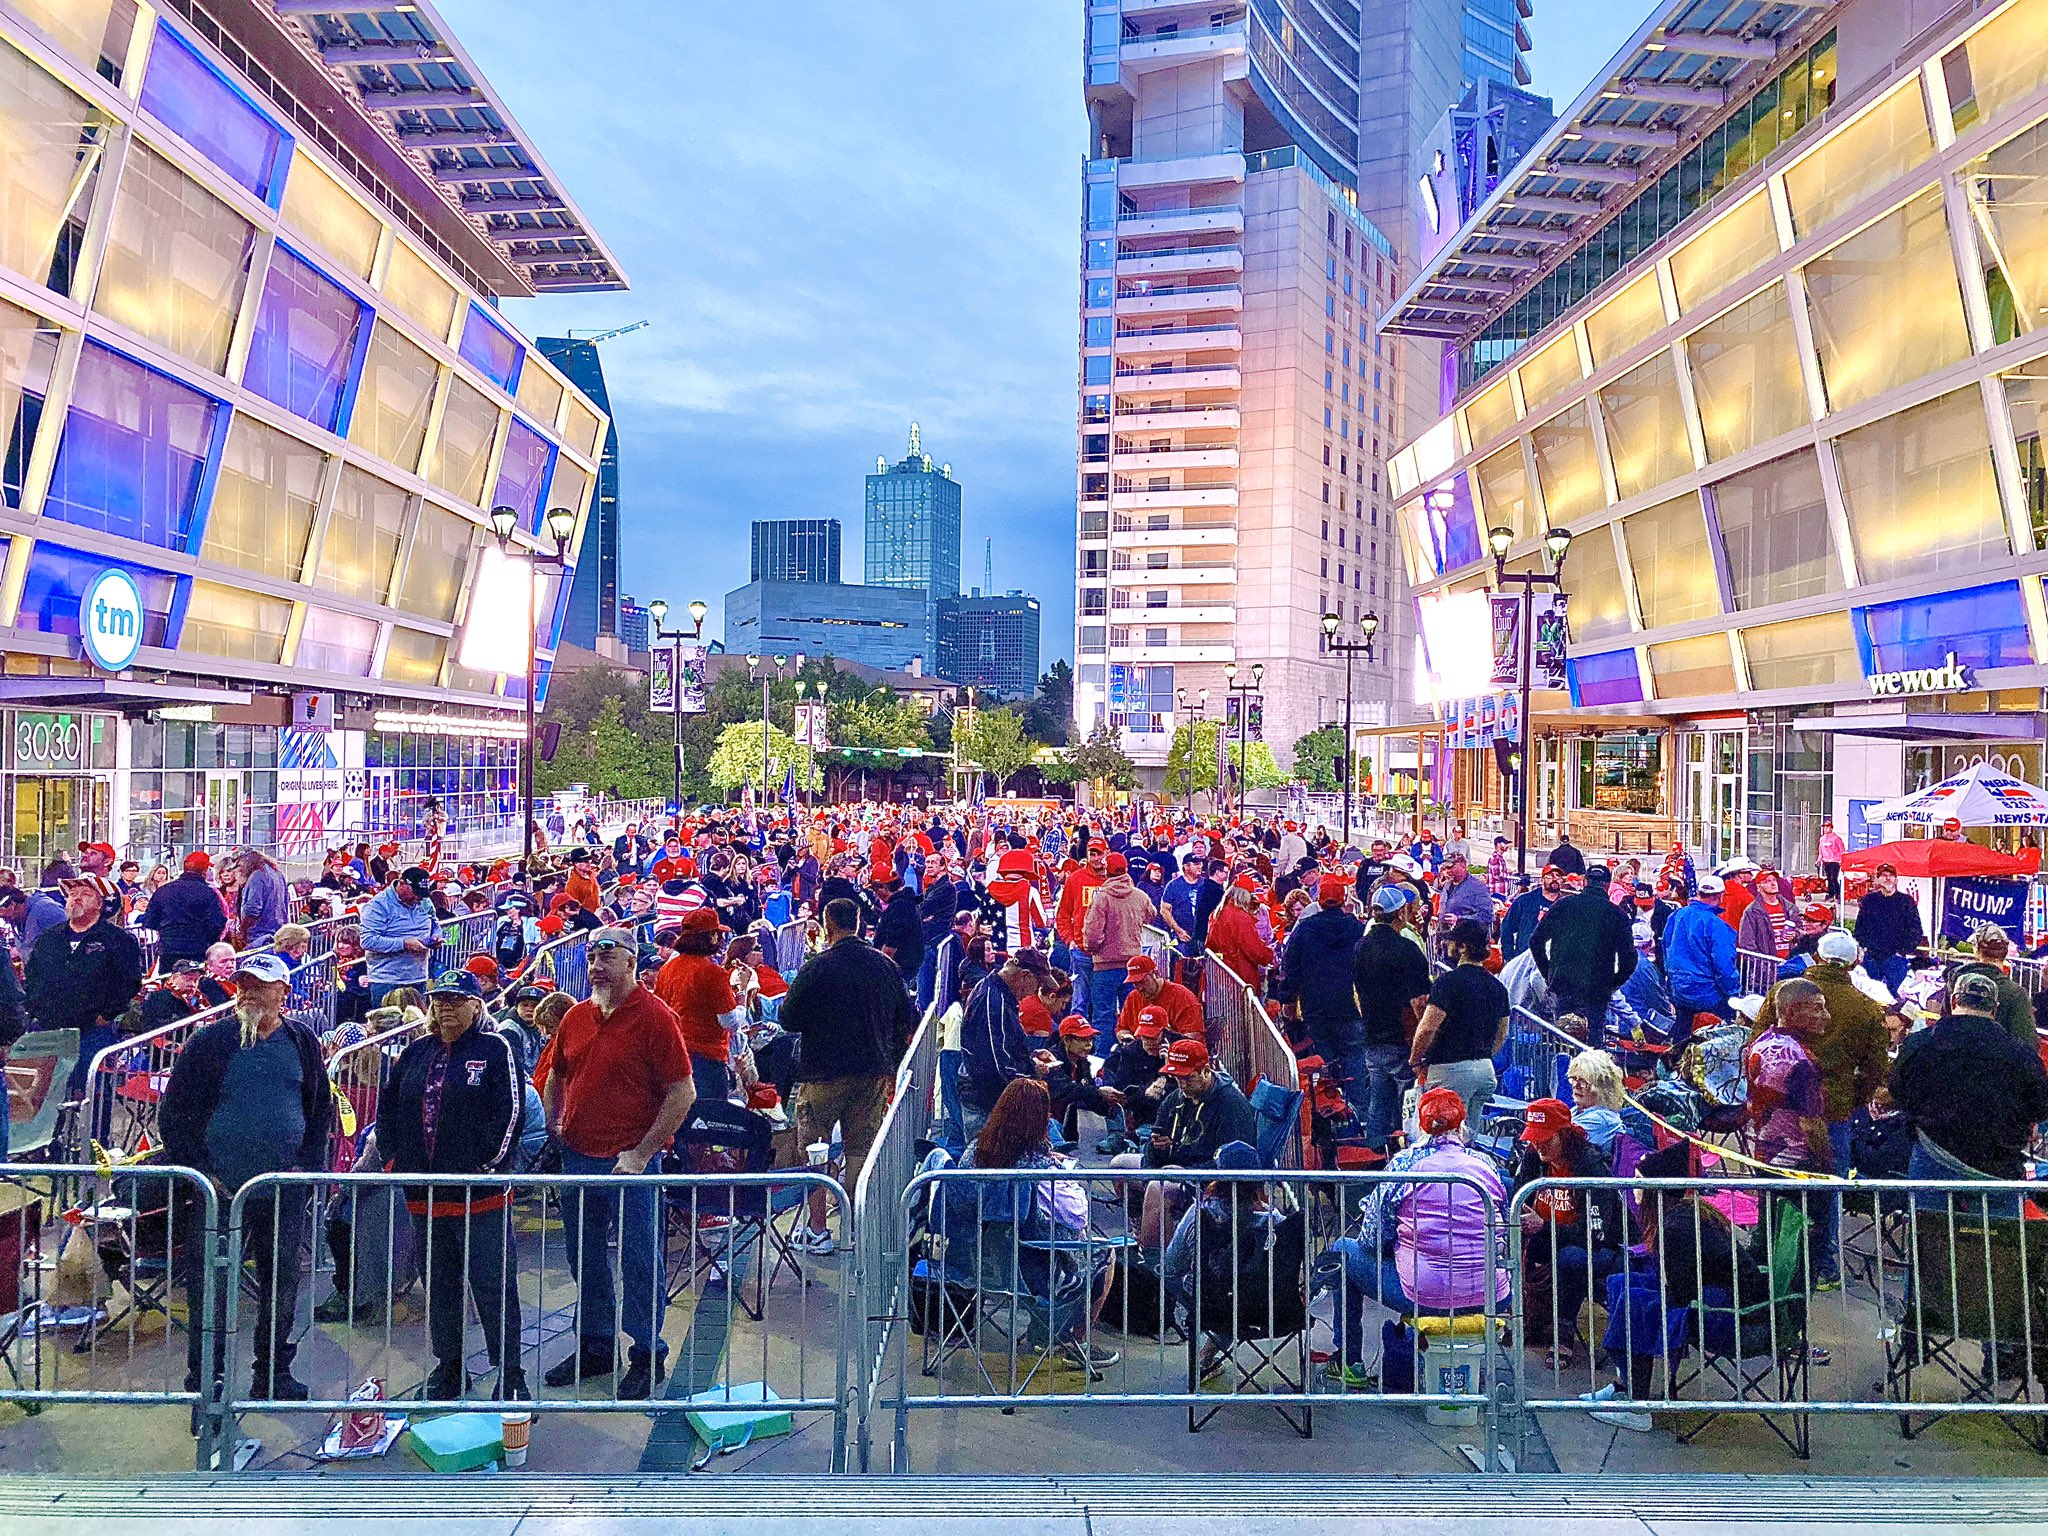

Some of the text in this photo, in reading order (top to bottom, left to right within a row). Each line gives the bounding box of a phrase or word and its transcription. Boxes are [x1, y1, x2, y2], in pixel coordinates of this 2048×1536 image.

[95, 598, 134, 637] tm
[1494, 604, 1502, 617] BE
[1494, 617, 1512, 630] LOUD
[1867, 651, 1968, 695] wework
[1445, 692, 1521, 749] HERO
[17, 721, 81, 761] 3030
[308, 780, 322, 790] LIVES
[1994, 813, 2031, 824] NEWS
[1951, 886, 2014, 916] TRUMP
